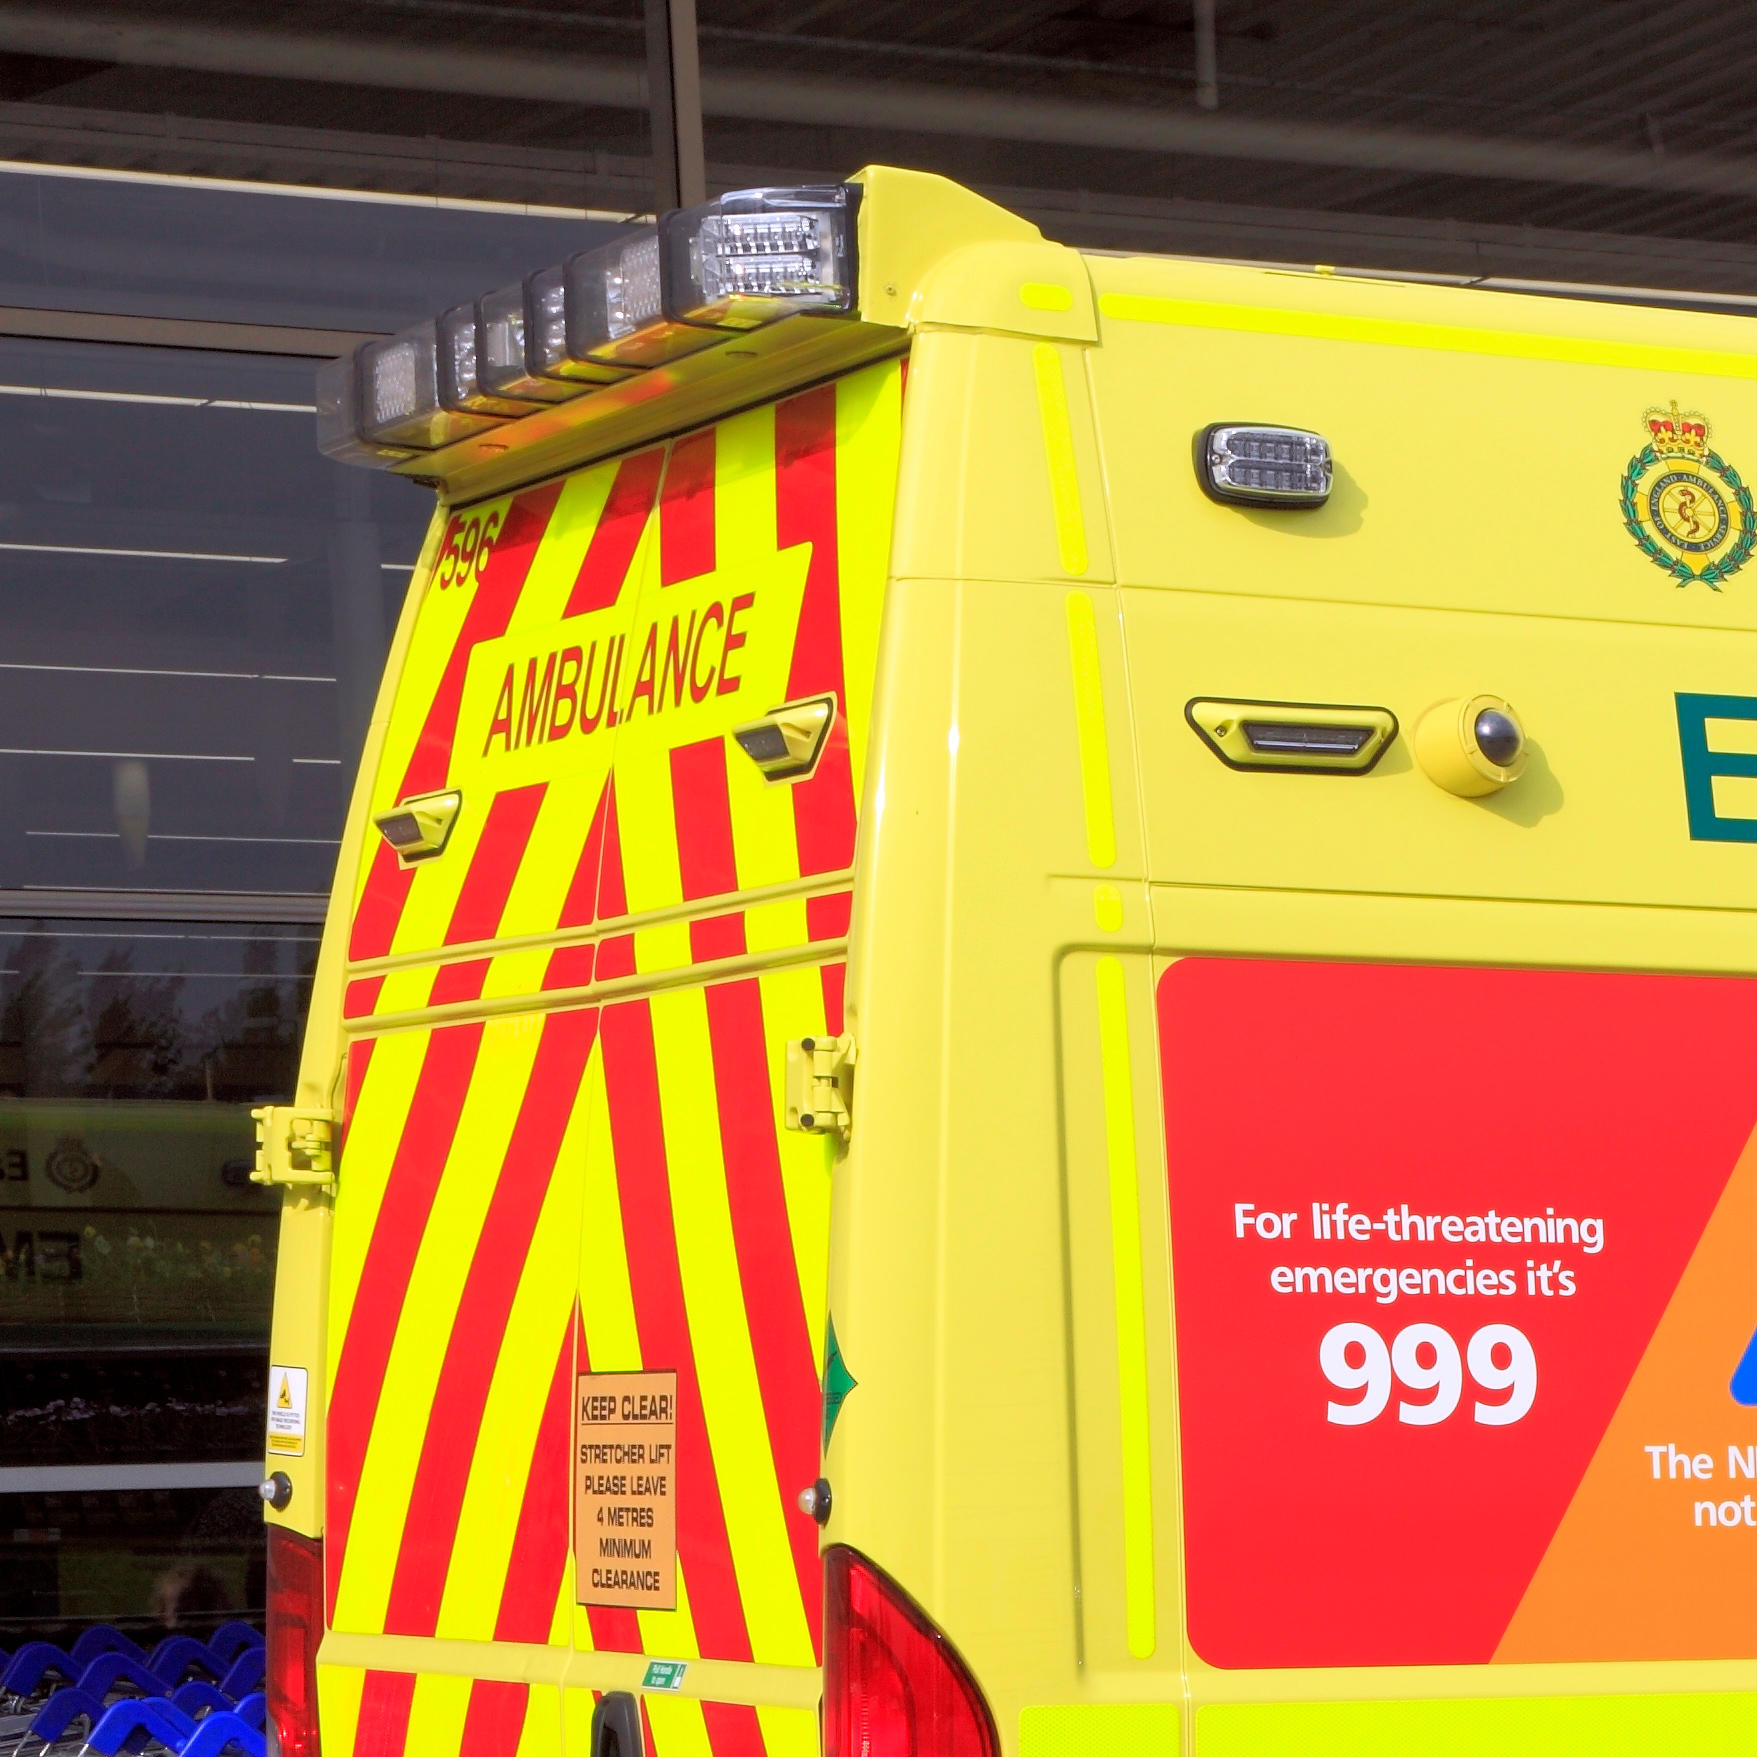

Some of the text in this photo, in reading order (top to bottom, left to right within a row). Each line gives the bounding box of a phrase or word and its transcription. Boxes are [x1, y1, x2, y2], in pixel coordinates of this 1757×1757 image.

[440, 510, 500, 590] 596
[481, 591, 756, 758] AMBULANCE
[1233, 1201, 1605, 1254] For life-threatening
[1270, 1258, 1577, 1305] emergencies it's
[1318, 1321, 1538, 1426] 999
[581, 1394, 673, 1421] KEEP CLEAR!
[580, 1443, 672, 1464] STRETCHER LIFT
[1644, 1444, 1714, 1479] The
[585, 1475, 667, 1496] PLEASE LEAVE
[597, 1506, 654, 1527] 4 METRES
[1694, 1494, 1756, 1527] not
[599, 1537, 651, 1559] MINIMUM
[592, 1568, 660, 1592] CLEARANCE
